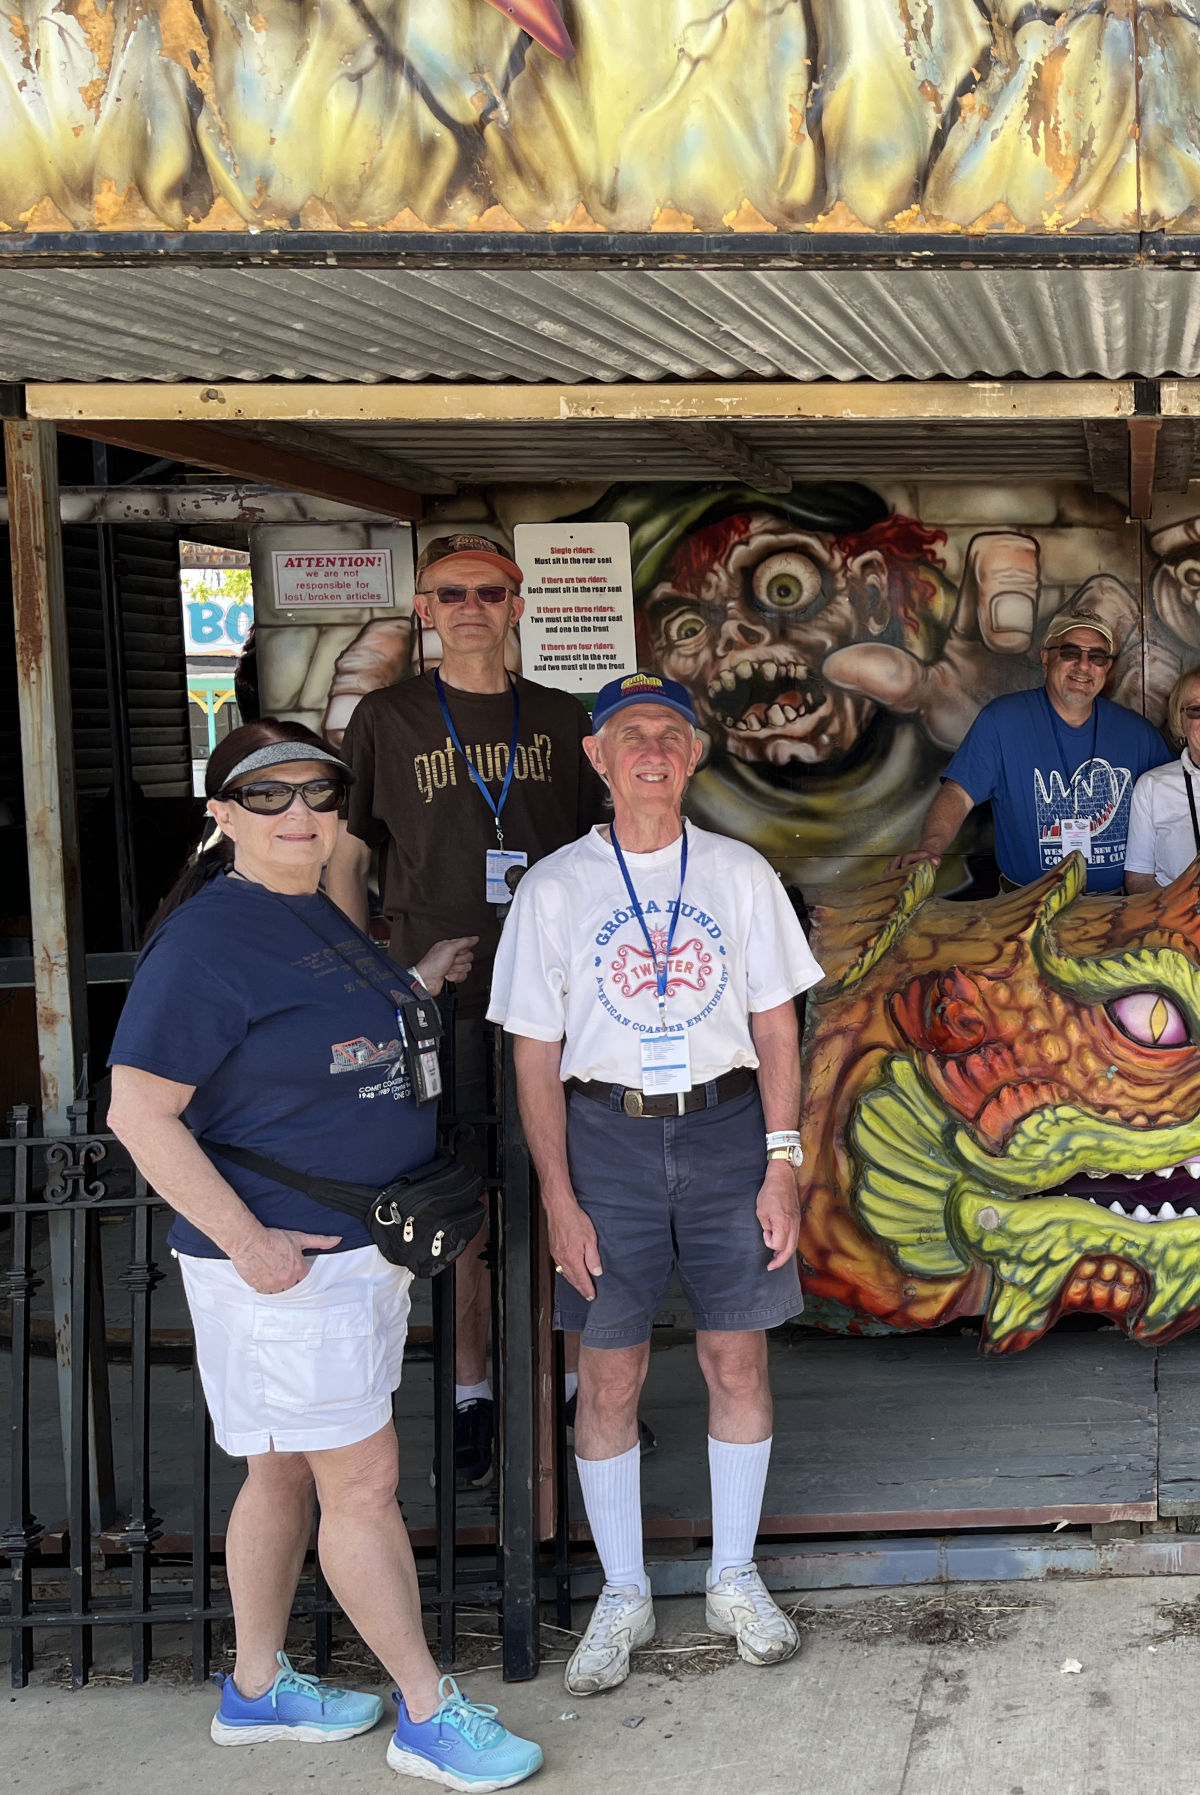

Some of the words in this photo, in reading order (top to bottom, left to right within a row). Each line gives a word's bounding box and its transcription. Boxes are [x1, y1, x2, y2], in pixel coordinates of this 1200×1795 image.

[284, 557, 382, 568] ATTENTION!
[296, 581, 351, 591] responsible
[187, 601, 254, 644] BO
[414, 736, 457, 804] got
[465, 734, 552, 783] wood?
[1110, 851, 1126, 862] CLU
[631, 959, 694, 979] TWISTER
